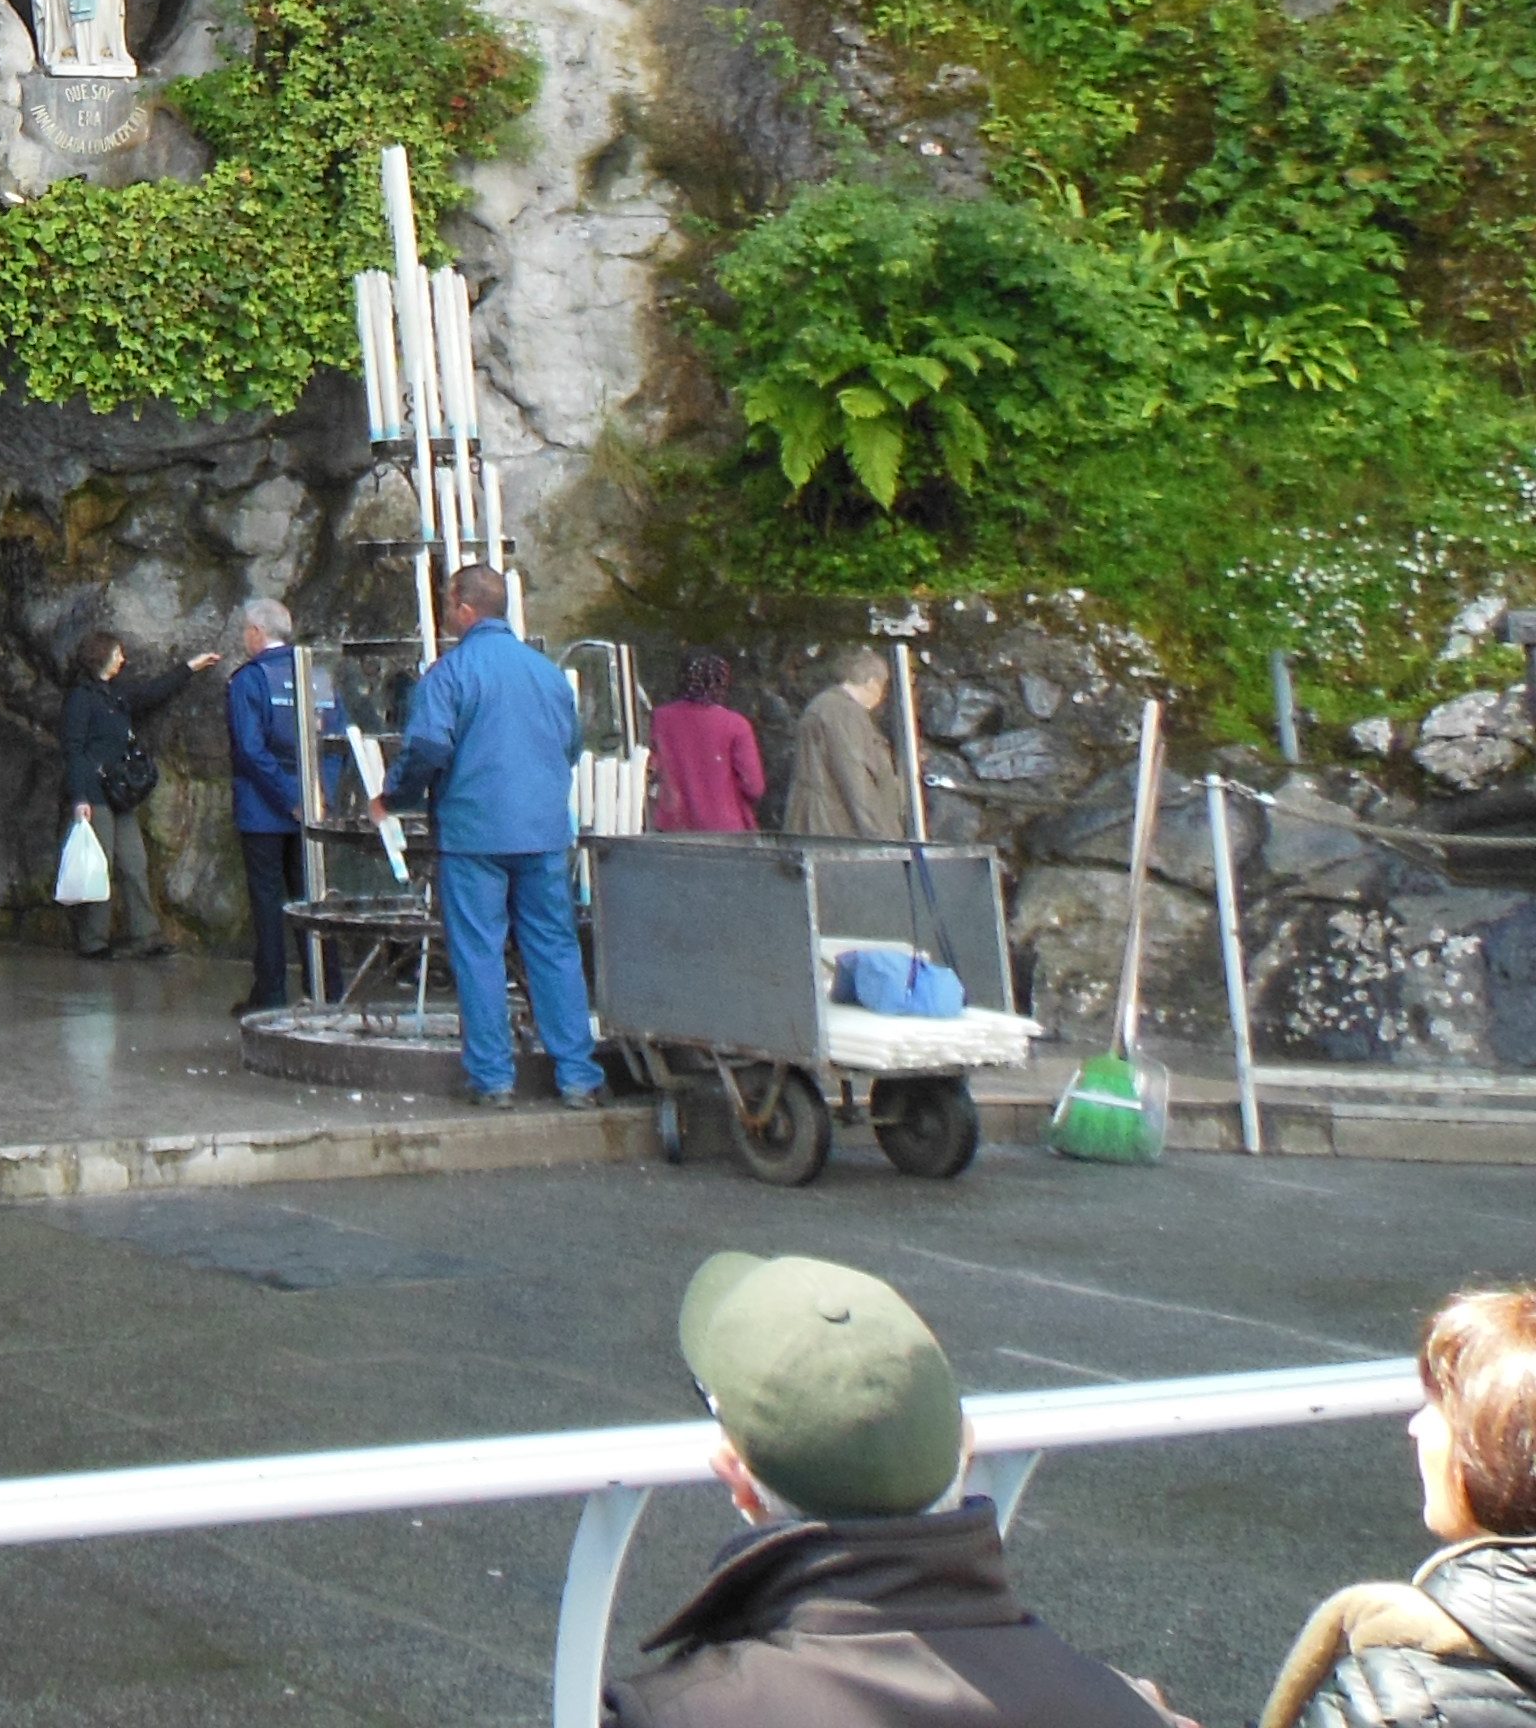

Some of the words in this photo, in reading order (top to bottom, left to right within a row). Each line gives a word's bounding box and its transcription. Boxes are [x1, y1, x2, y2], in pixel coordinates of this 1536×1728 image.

[65, 84, 88, 102] QUE
[91, 84, 115, 103] SOY
[78, 110, 102, 127] ERA
